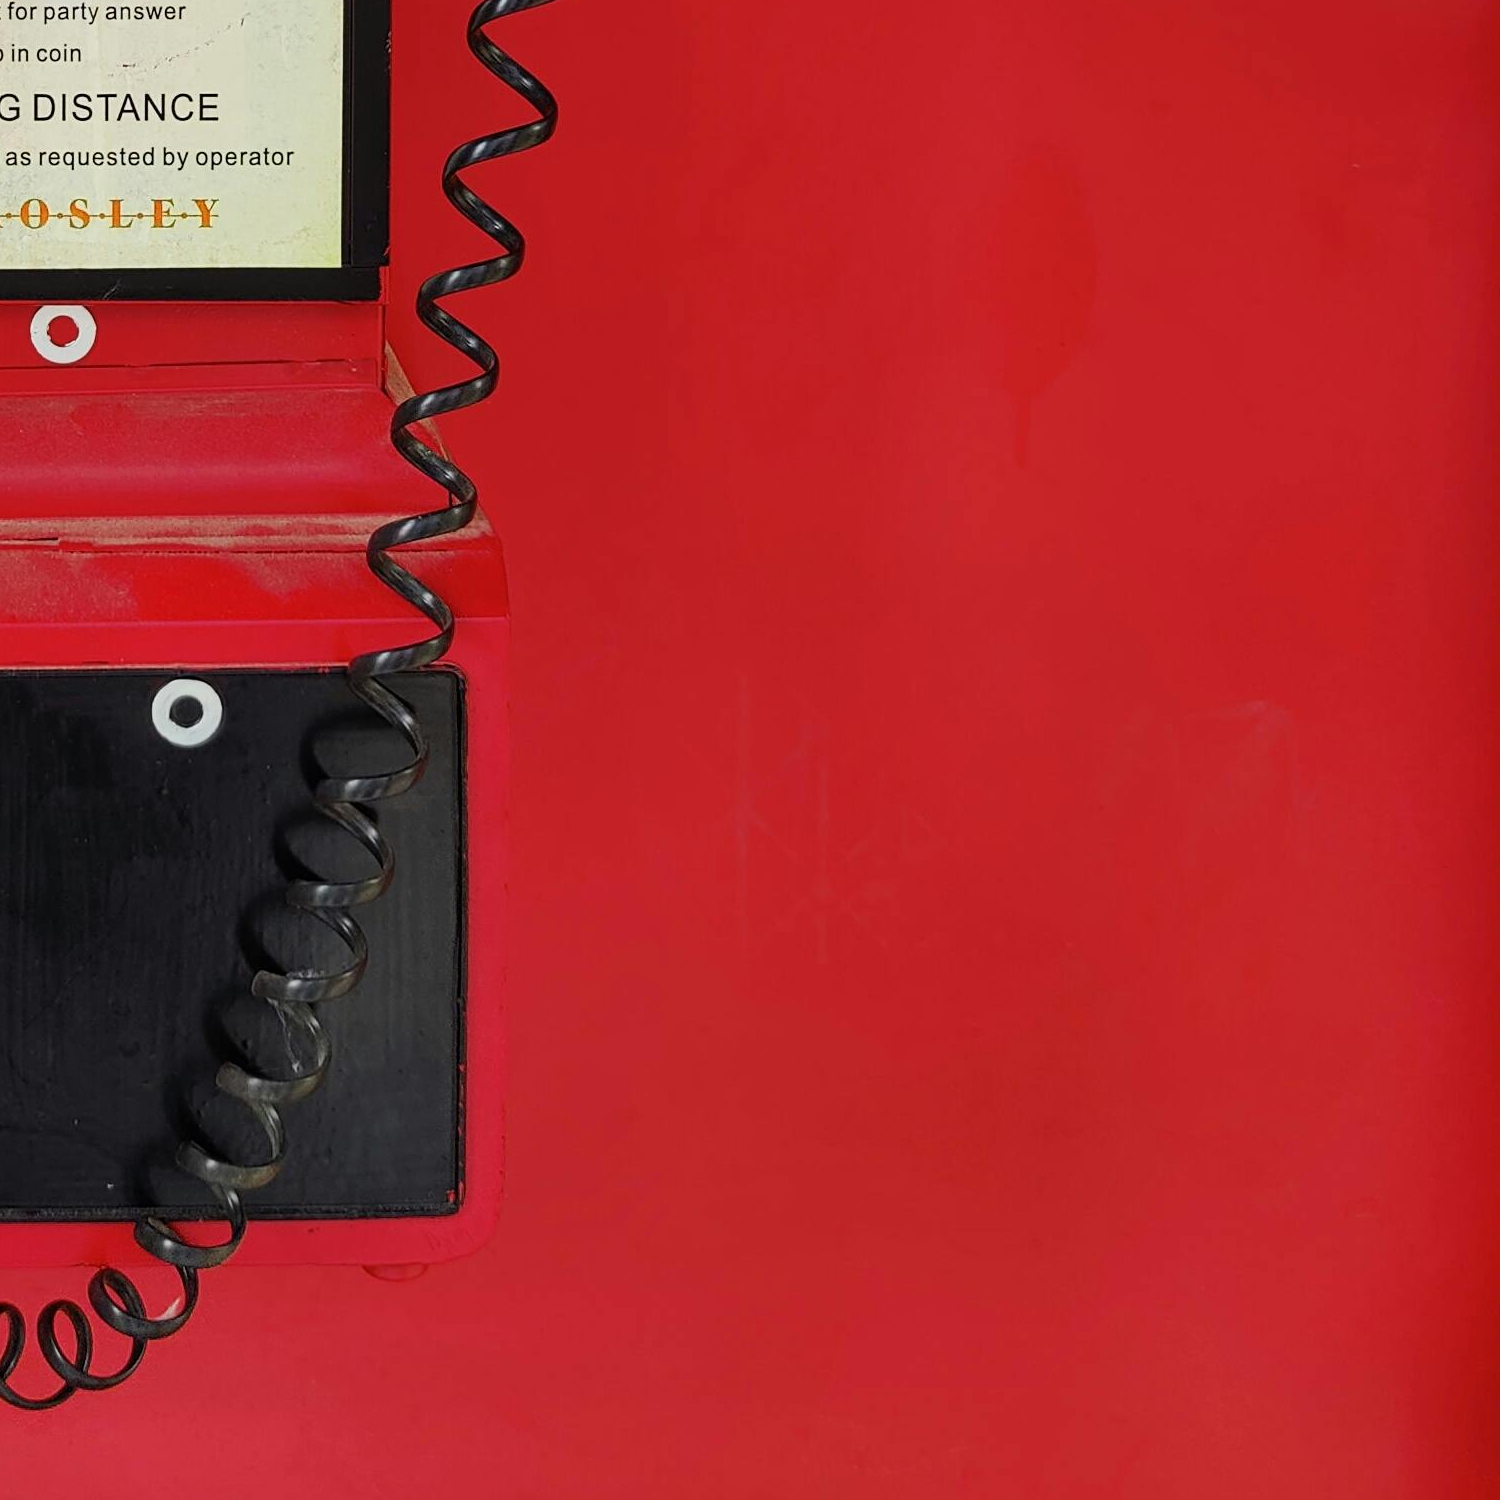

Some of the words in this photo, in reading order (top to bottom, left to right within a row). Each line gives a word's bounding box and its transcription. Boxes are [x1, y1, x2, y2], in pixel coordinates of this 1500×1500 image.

[8, 2, 37, 20] for
[44, 3, 98, 24] party
[106, 6, 186, 20] answer
[12, 45, 28, 62] in
[37, 45, 81, 62] coin
[34, 94, 218, 121] DISTANCE
[6, 152, 31, 165] as
[40, 147, 154, 170] requested
[164, 147, 188, 171] by
[196, 148, 294, 170] operator
